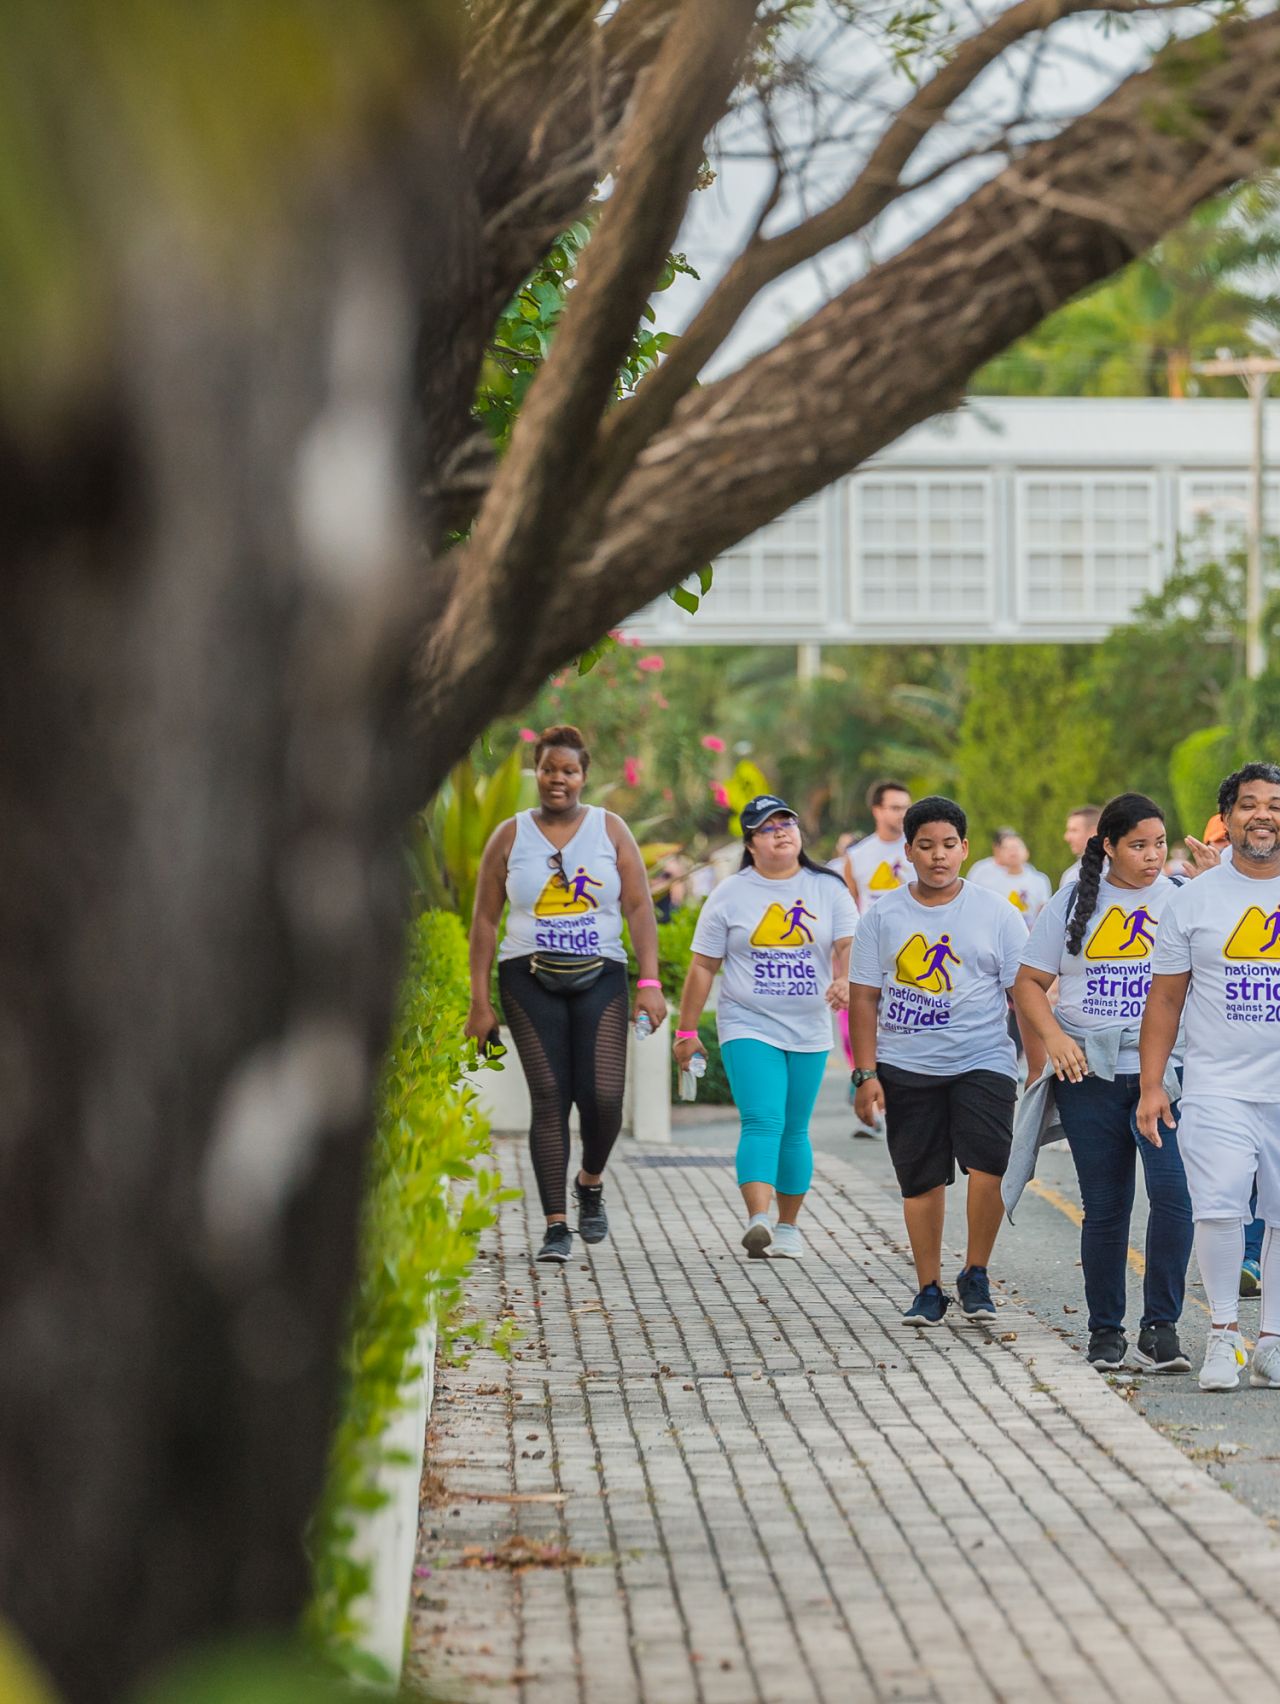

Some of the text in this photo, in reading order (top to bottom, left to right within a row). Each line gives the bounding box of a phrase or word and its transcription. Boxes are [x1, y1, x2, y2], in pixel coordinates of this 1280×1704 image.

[536, 929, 599, 950] stride
[754, 960, 816, 979] stride
[1085, 962, 1151, 976] nationwid
[787, 981, 818, 996] 2021
[889, 987, 952, 1009] nationwide
[1082, 998, 1118, 1007] against
[887, 1002, 950, 1026] stride
[1082, 1000, 1146, 1018] cancer 20
[1225, 1003, 1263, 1012] against
[1226, 1012, 1263, 1022] cancer
